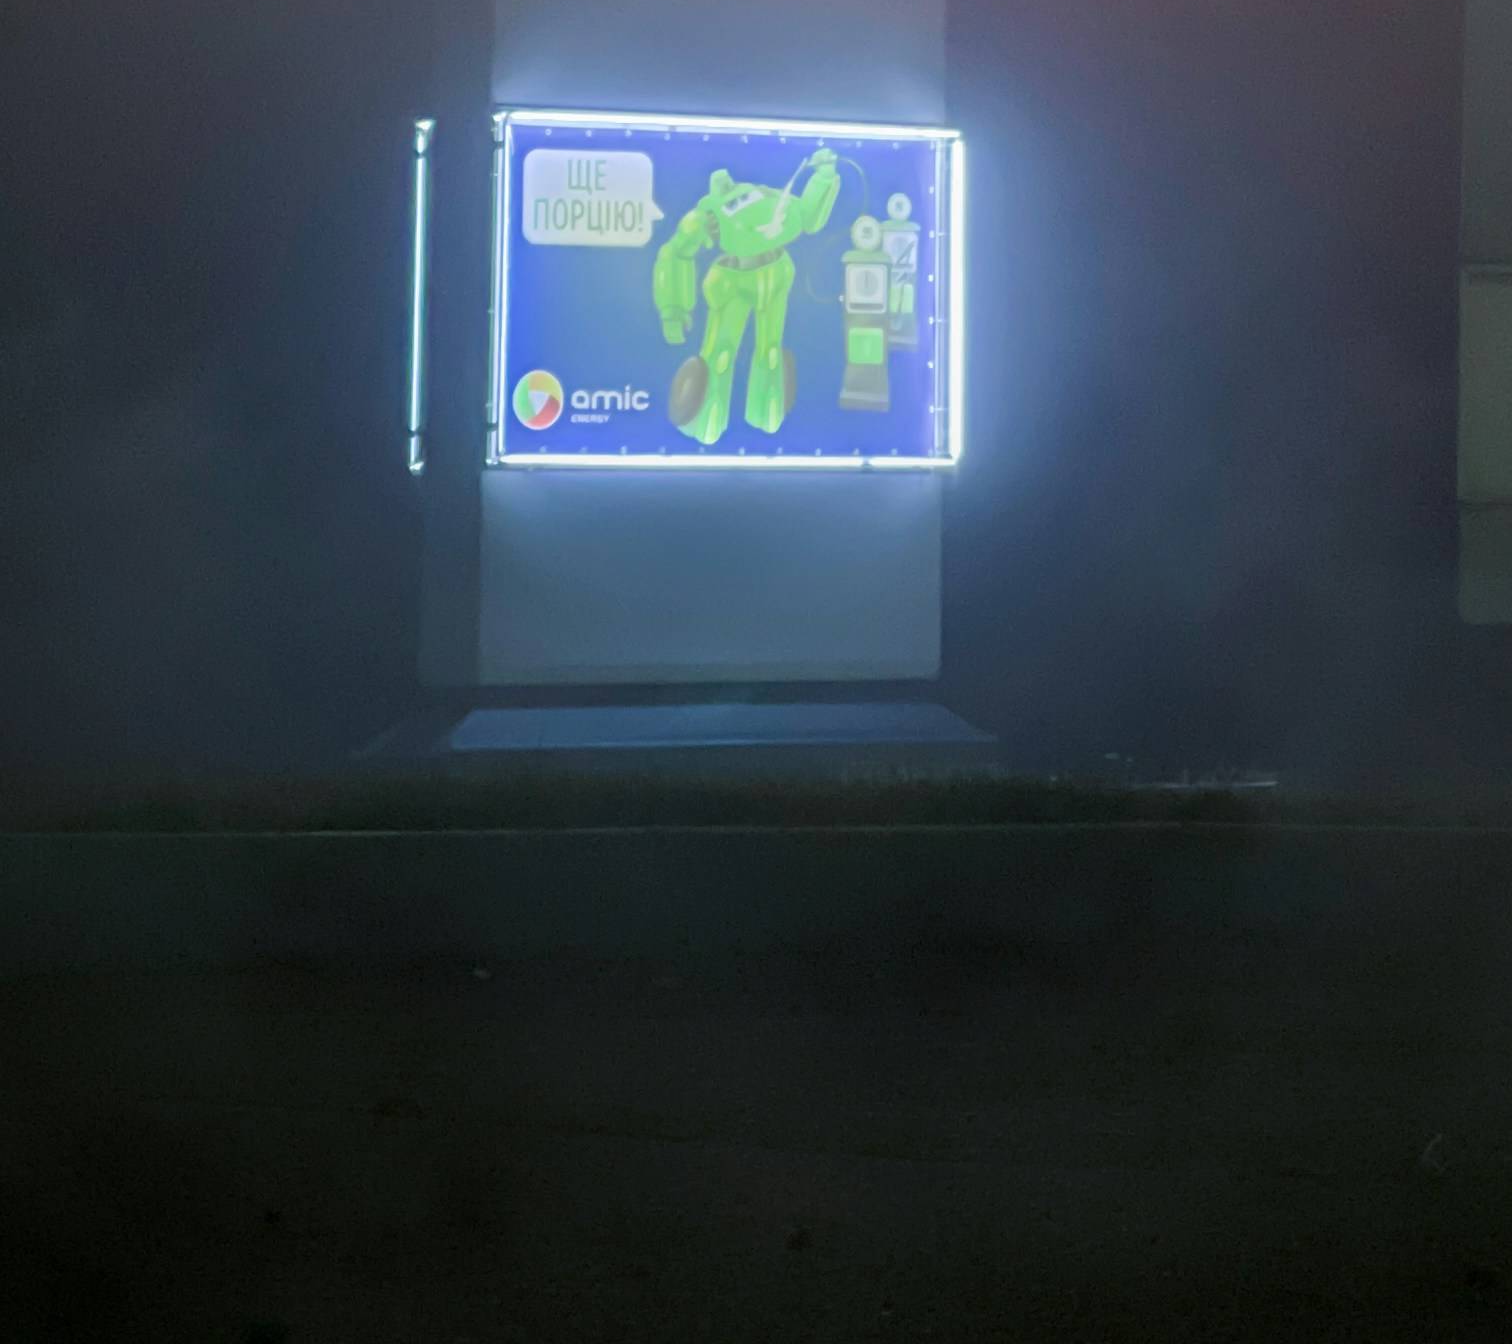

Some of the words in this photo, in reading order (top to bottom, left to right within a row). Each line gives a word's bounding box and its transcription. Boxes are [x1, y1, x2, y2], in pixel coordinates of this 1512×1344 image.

[567, 159, 607, 195] ЩЕ
[533, 198, 644, 236] ПОРЦІЮ!
[571, 384, 649, 411] amic
